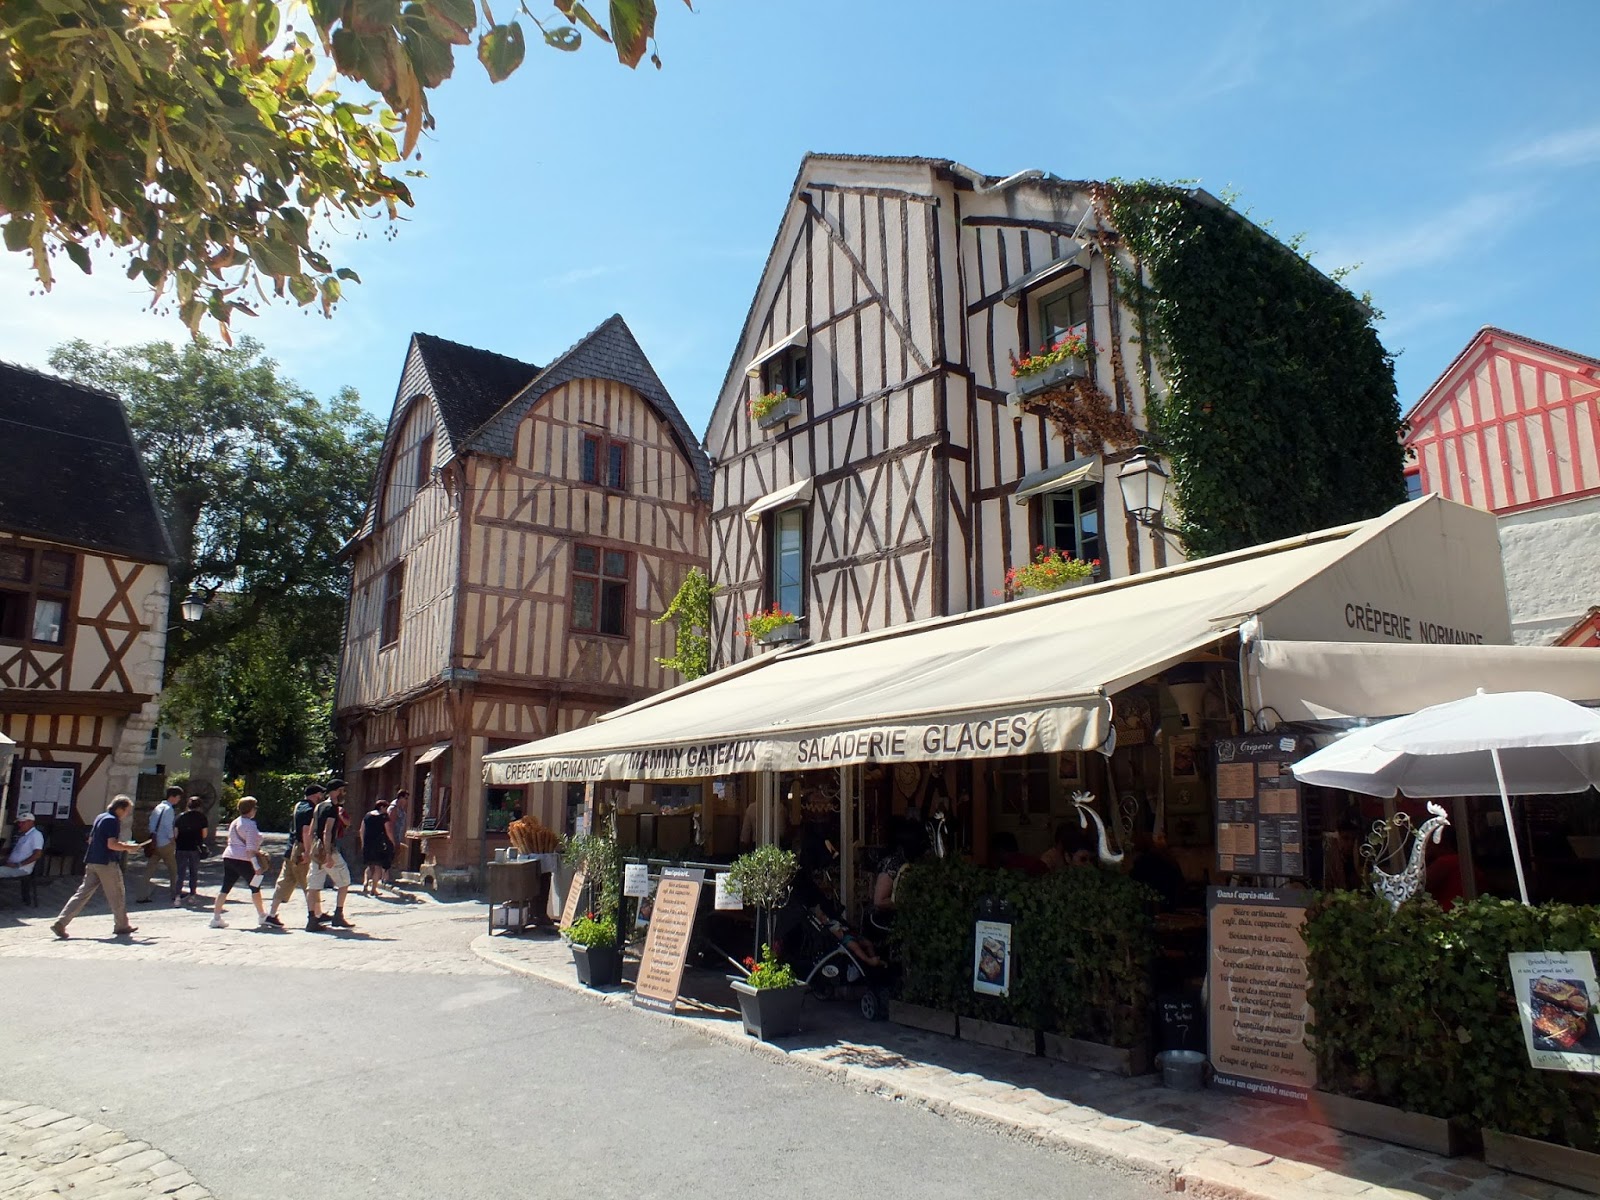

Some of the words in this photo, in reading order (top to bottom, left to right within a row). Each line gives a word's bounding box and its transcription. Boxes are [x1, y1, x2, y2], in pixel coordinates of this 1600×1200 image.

[1345, 602, 1412, 641] CRÊPERIE
[628, 746, 685, 770] MAMMY
[687, 739, 760, 767] GATEAUX
[798, 729, 907, 763] SALADERIE
[923, 716, 1027, 754] GLACES
[548, 758, 606, 778] NORMANDE
[664, 768, 694, 777] DEPUIS
